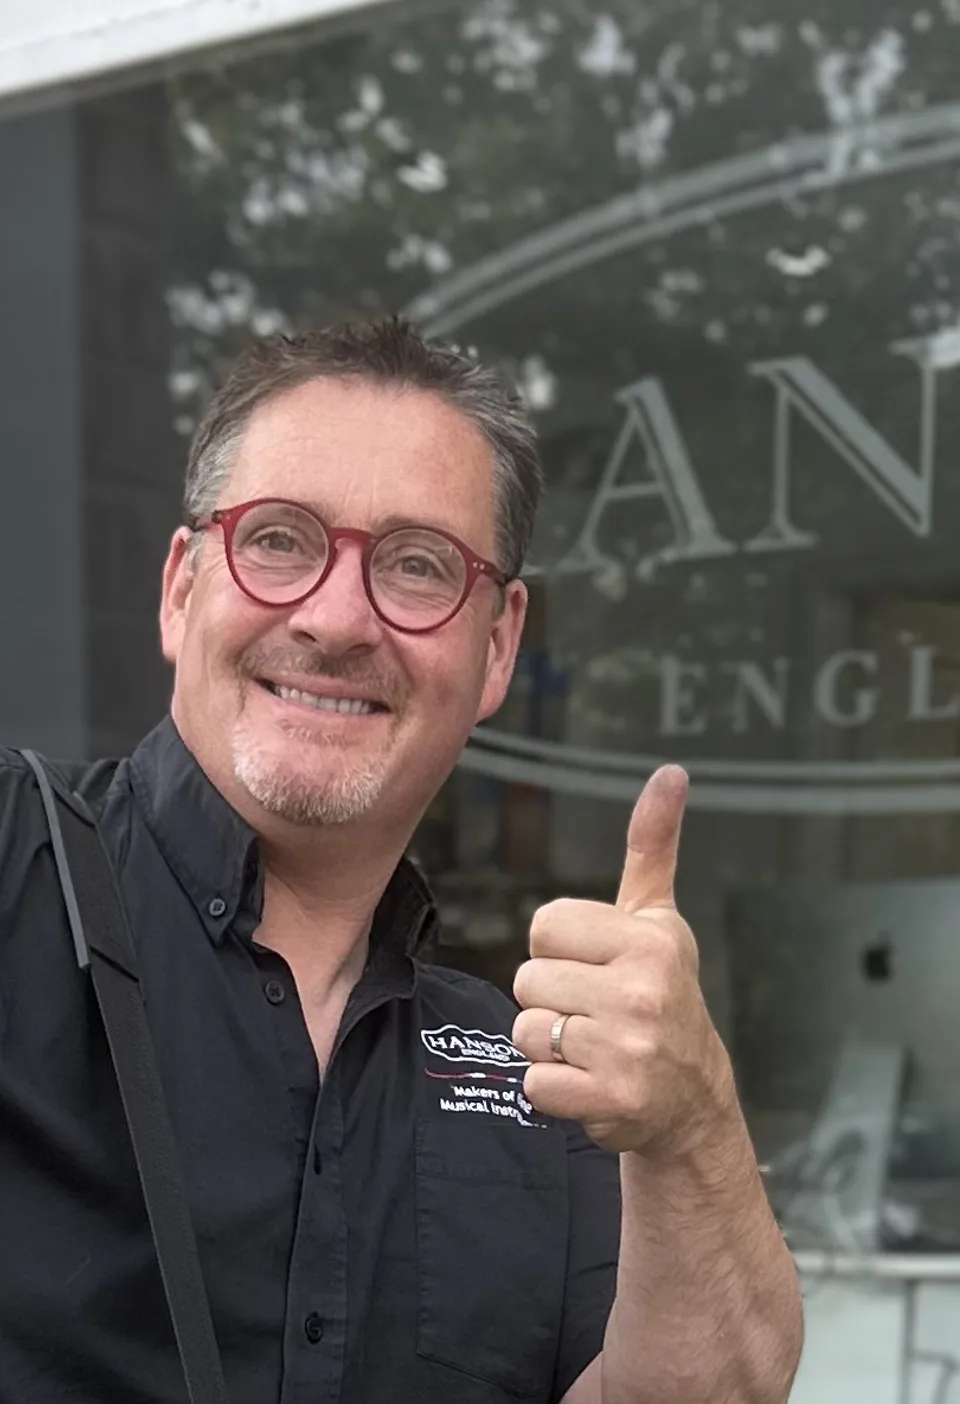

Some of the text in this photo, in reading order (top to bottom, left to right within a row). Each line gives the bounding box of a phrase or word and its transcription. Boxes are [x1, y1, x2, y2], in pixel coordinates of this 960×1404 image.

[520, 332, 960, 577] AN
[452, 1085, 500, 1100] Makers
[502, 1090, 515, 1102] of
[440, 1098, 490, 1113] Musical
